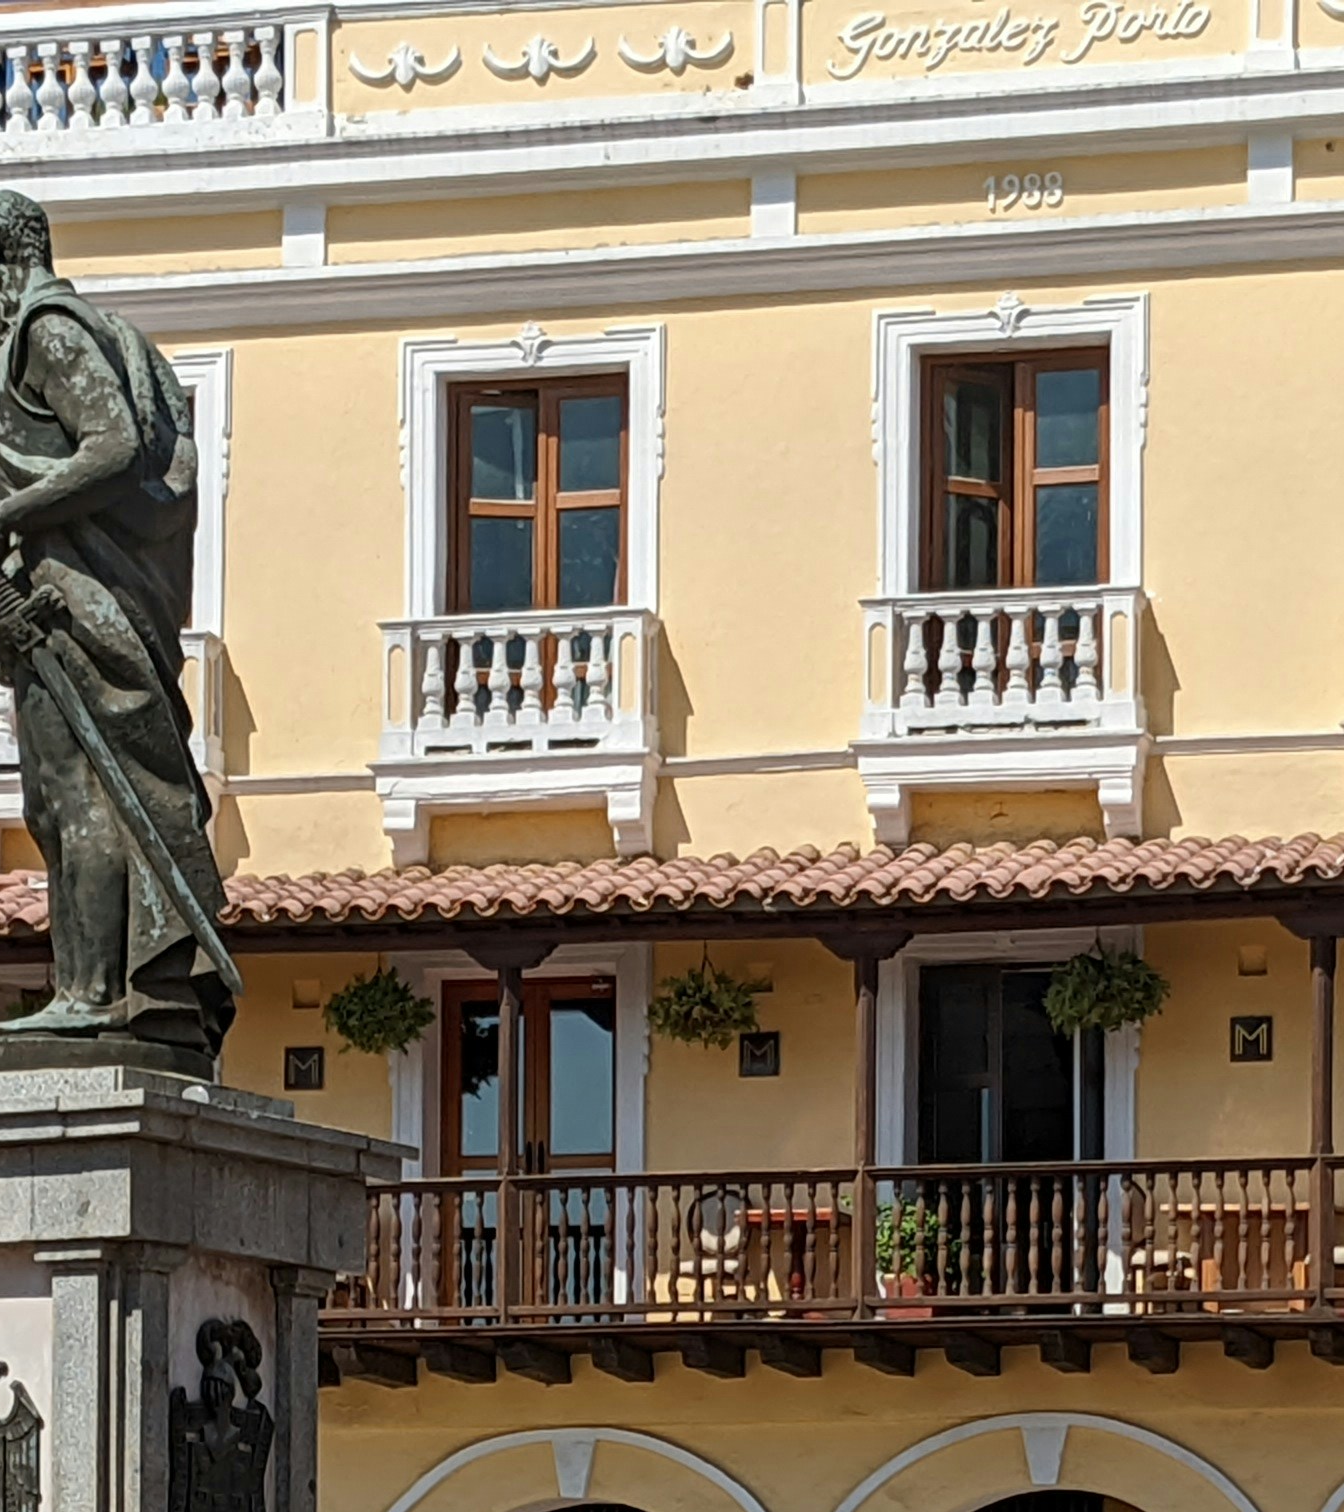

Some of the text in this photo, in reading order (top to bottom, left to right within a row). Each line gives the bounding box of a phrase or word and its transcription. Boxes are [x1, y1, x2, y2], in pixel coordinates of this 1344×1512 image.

[826, 0, 1212, 79] Gonzalez Porto
[982, 171, 1064, 212] 1988
[1235, 1022, 1268, 1055] M
[288, 1052, 320, 1085] M
